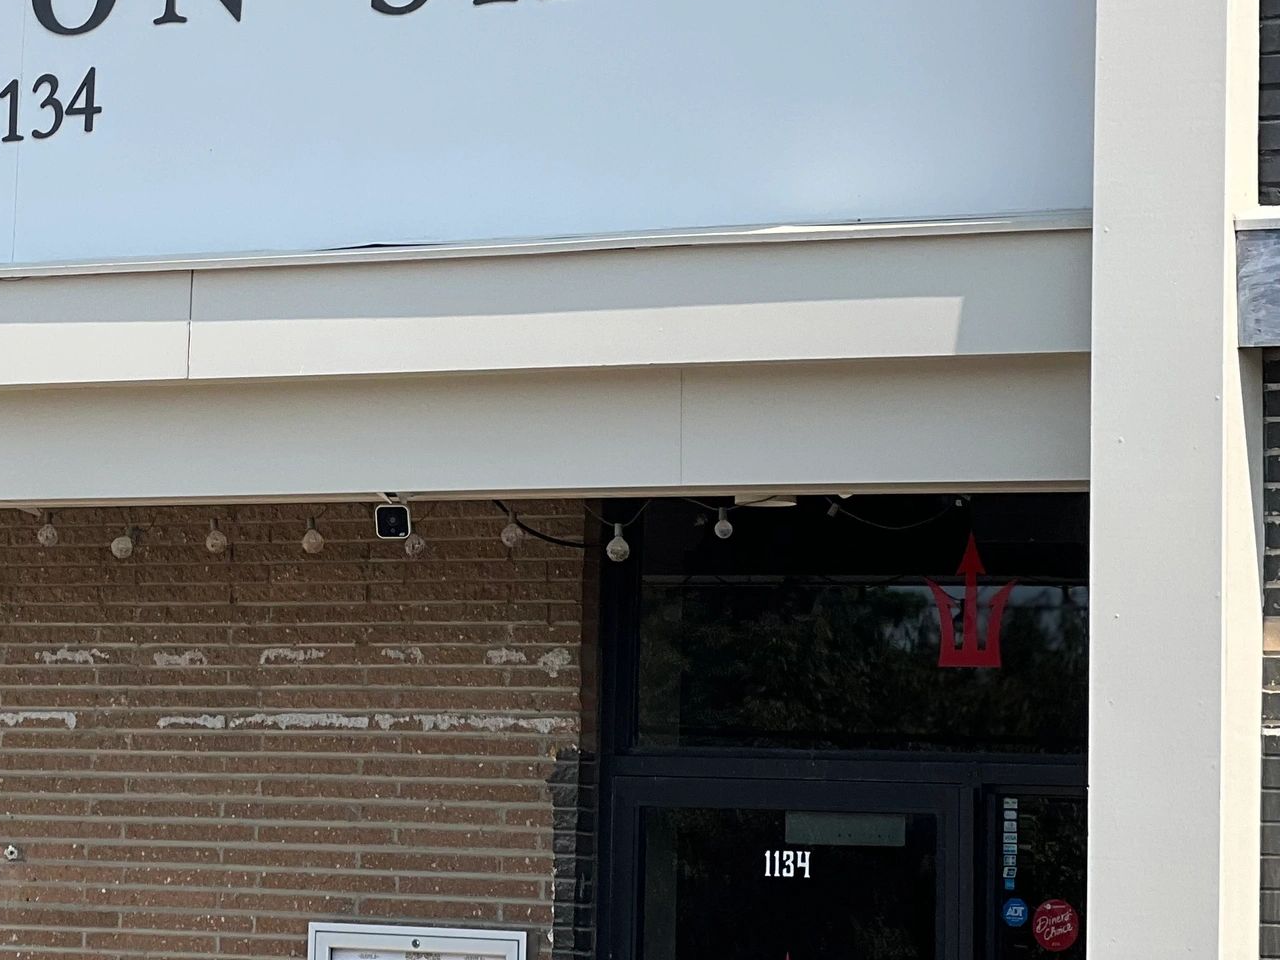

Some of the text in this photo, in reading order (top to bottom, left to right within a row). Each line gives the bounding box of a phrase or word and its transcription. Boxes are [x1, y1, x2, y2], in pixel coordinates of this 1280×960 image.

[764, 849, 811, 878] 1134
[1006, 906, 1025, 917] ADT
[1043, 923, 1073, 940] Choice
